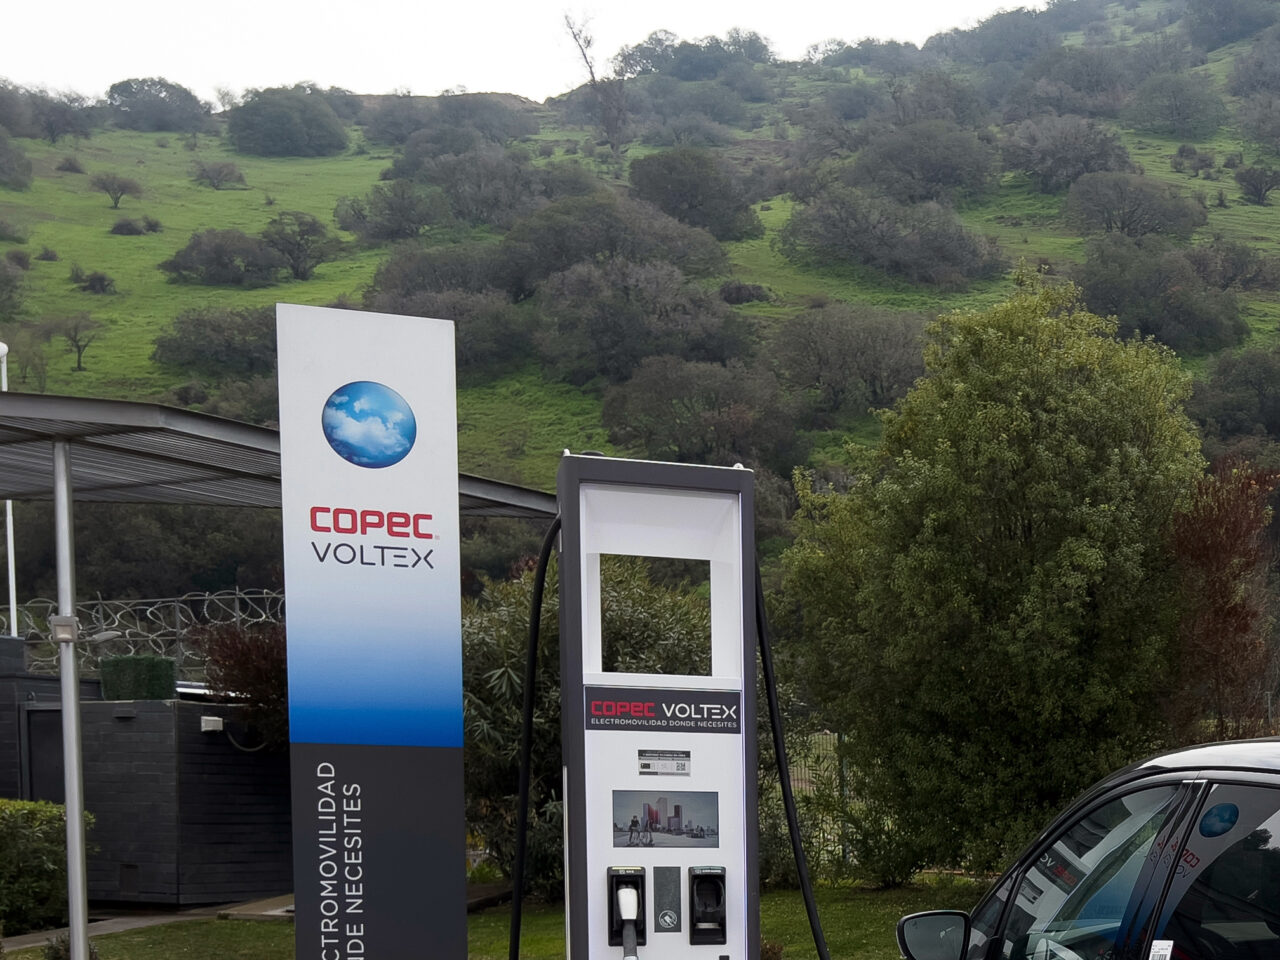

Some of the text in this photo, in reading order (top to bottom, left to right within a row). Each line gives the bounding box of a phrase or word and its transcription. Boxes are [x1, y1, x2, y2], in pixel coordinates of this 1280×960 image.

[311, 541, 434, 569] VOLTEX
[662, 703, 737, 719] VOLTEX
[591, 718, 738, 729] ELECTROMOVILIDAD DONDE NECESITES
[342, 783, 364, 913] NECESITES
